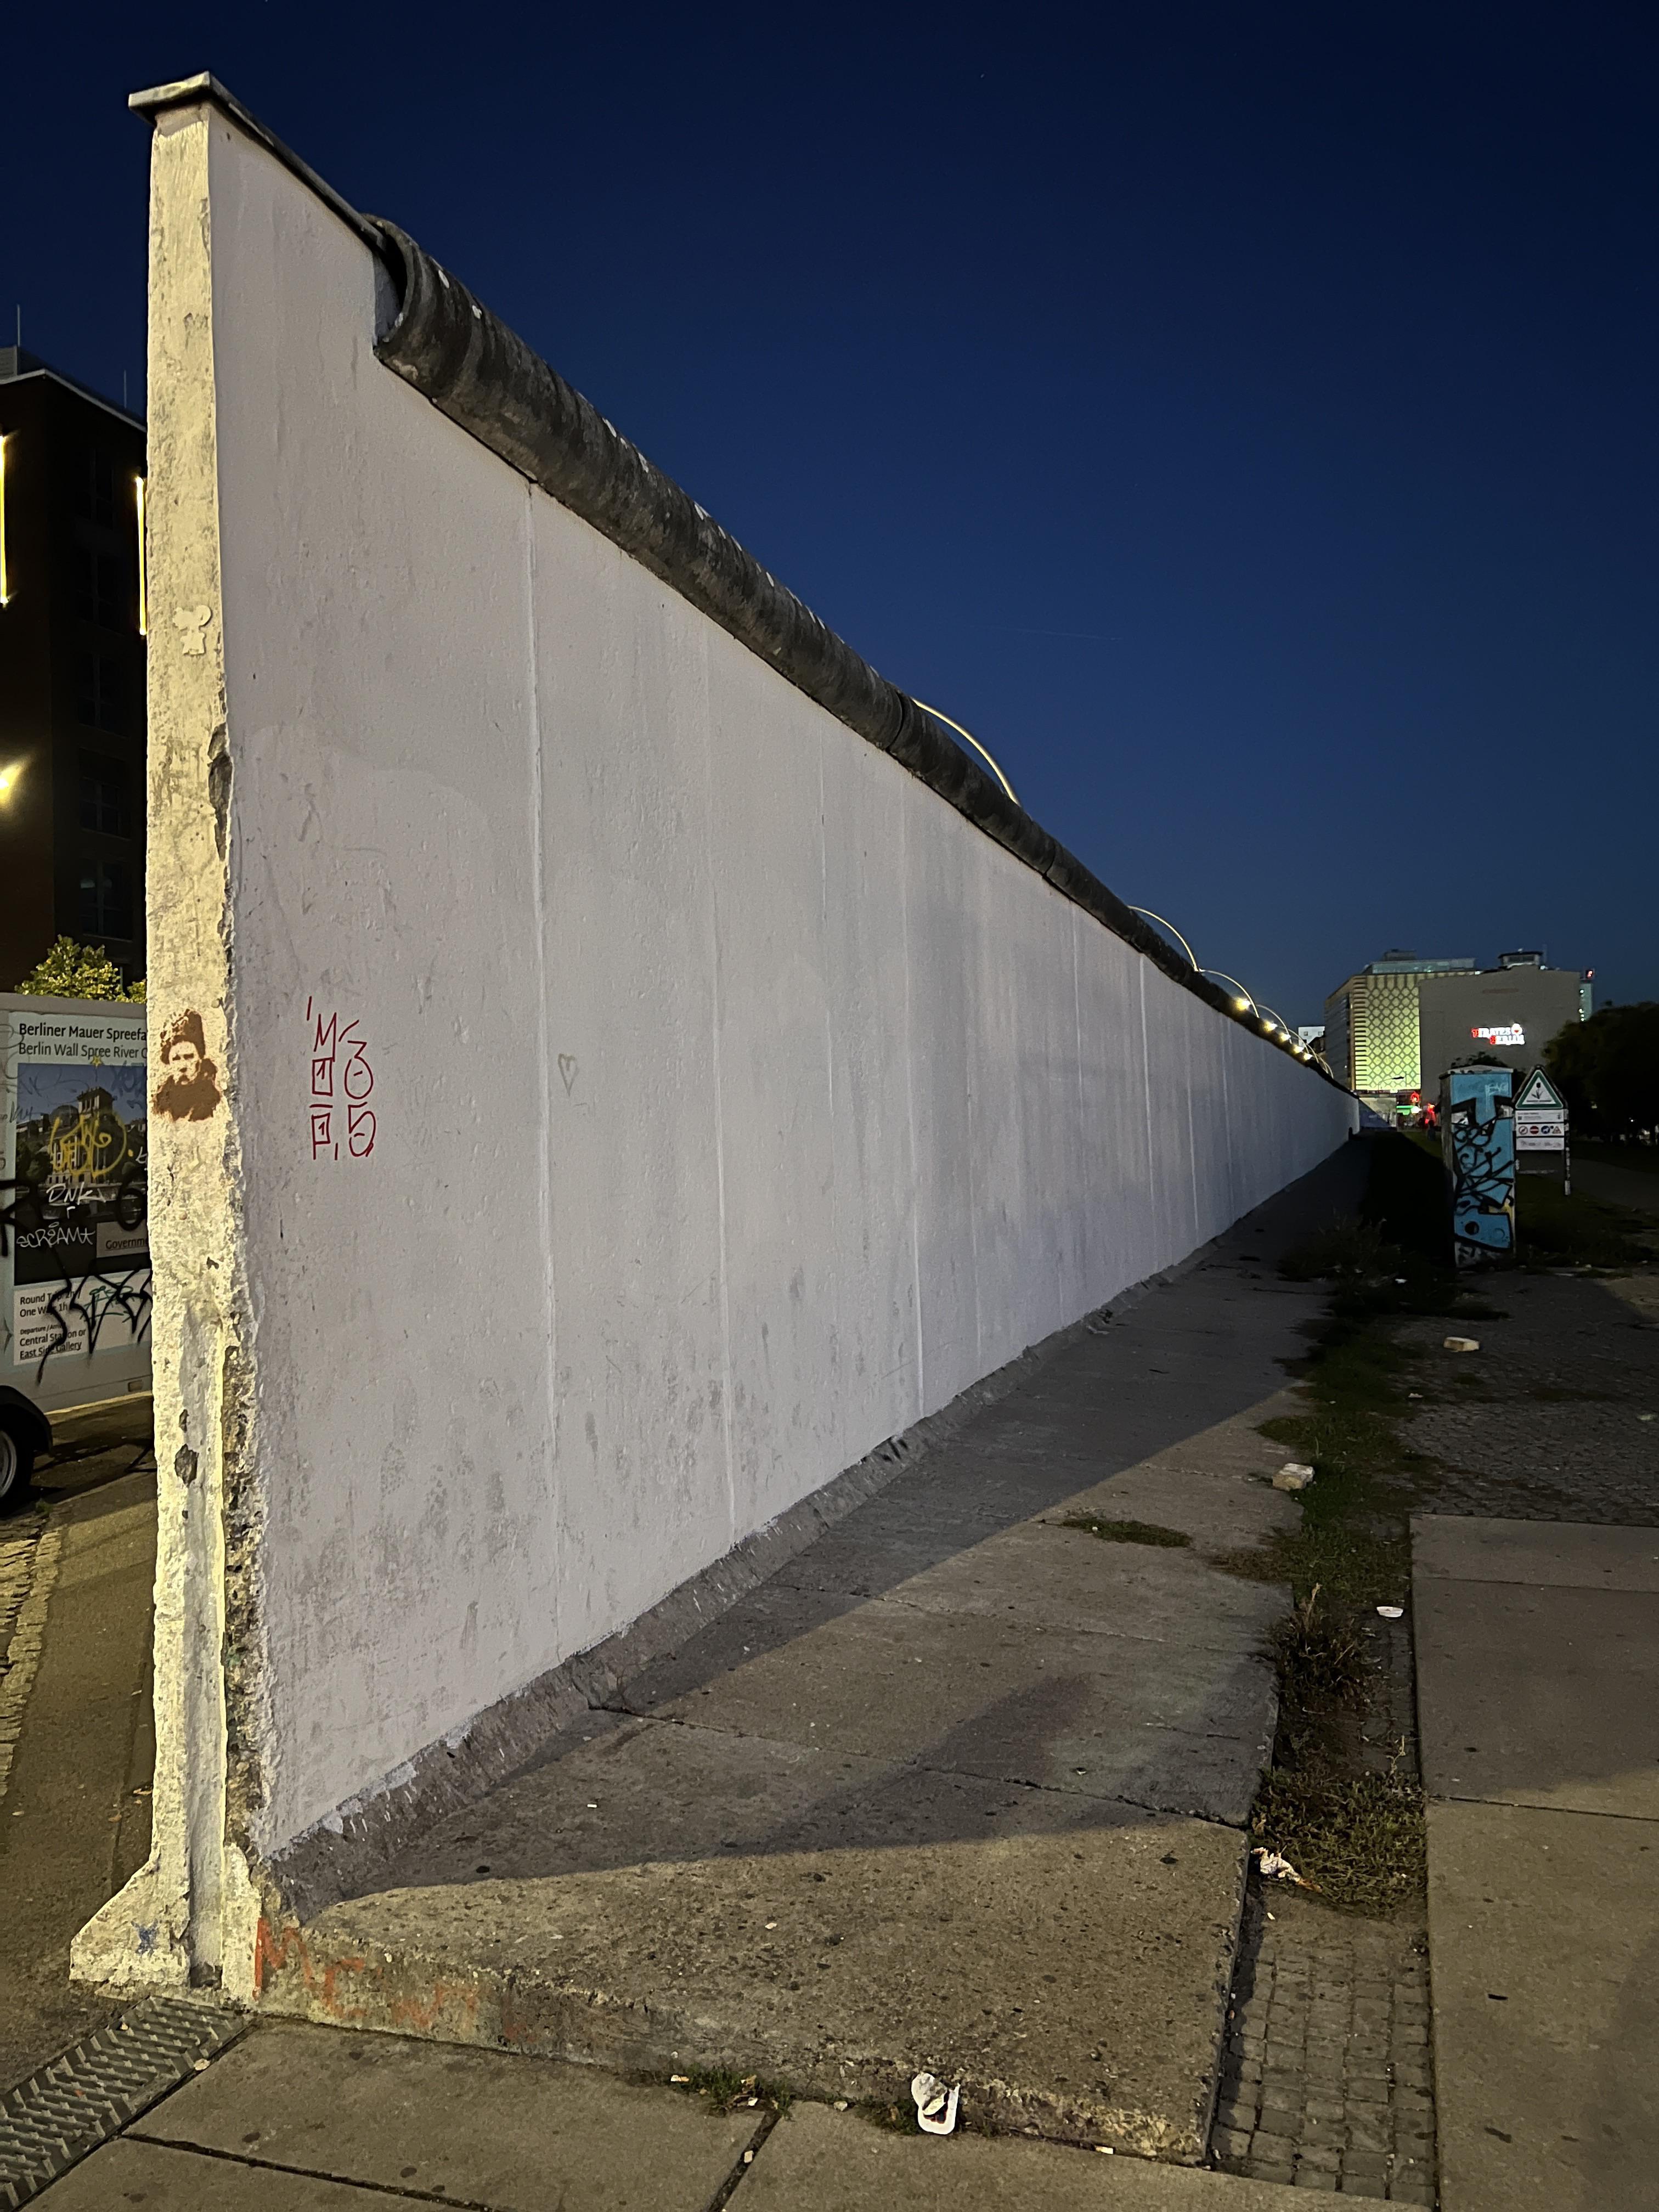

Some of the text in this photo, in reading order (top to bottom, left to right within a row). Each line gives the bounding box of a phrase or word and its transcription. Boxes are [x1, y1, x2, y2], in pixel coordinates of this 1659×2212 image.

[19, 1023, 146, 1042] Berliner Mauer Spreefa
[19, 1042, 51, 1055] Berlin
[54, 1043, 78, 1057] Wall
[81, 1045, 110, 1060] Spree
[114, 1045, 138, 1058] River
[106, 1238, 148, 1249] Governm
[20, 1293, 45, 1305] Round
[20, 1308, 36, 1317] One
[20, 1326, 46, 1335] Departure
[20, 1334, 48, 1346] Central
[20, 1349, 36, 1359] East
[56, 1342, 82, 1352] Gallery
